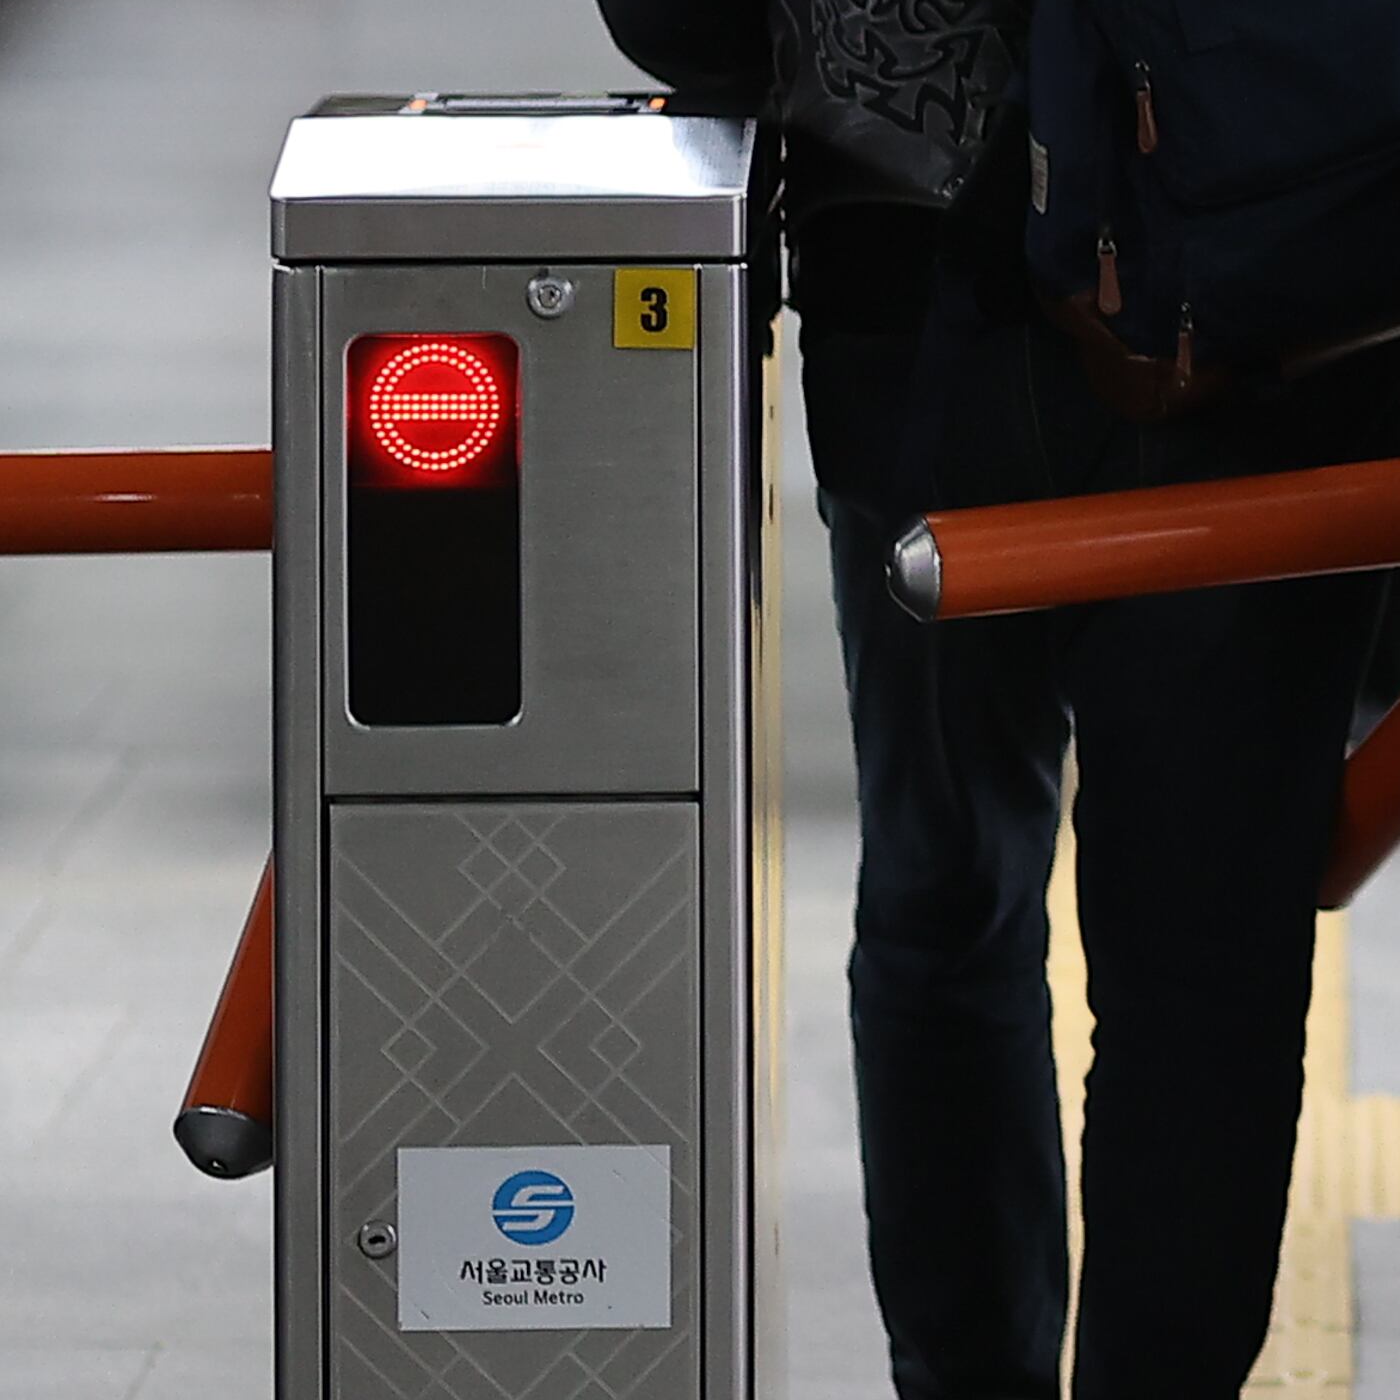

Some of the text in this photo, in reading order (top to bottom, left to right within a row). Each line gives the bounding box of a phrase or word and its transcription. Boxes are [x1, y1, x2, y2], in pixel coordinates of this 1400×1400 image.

[640, 287, 668, 332] 3
[460, 1258, 607, 1285] 서울교통공사
[483, 1290, 584, 1306] Seoul Metro
